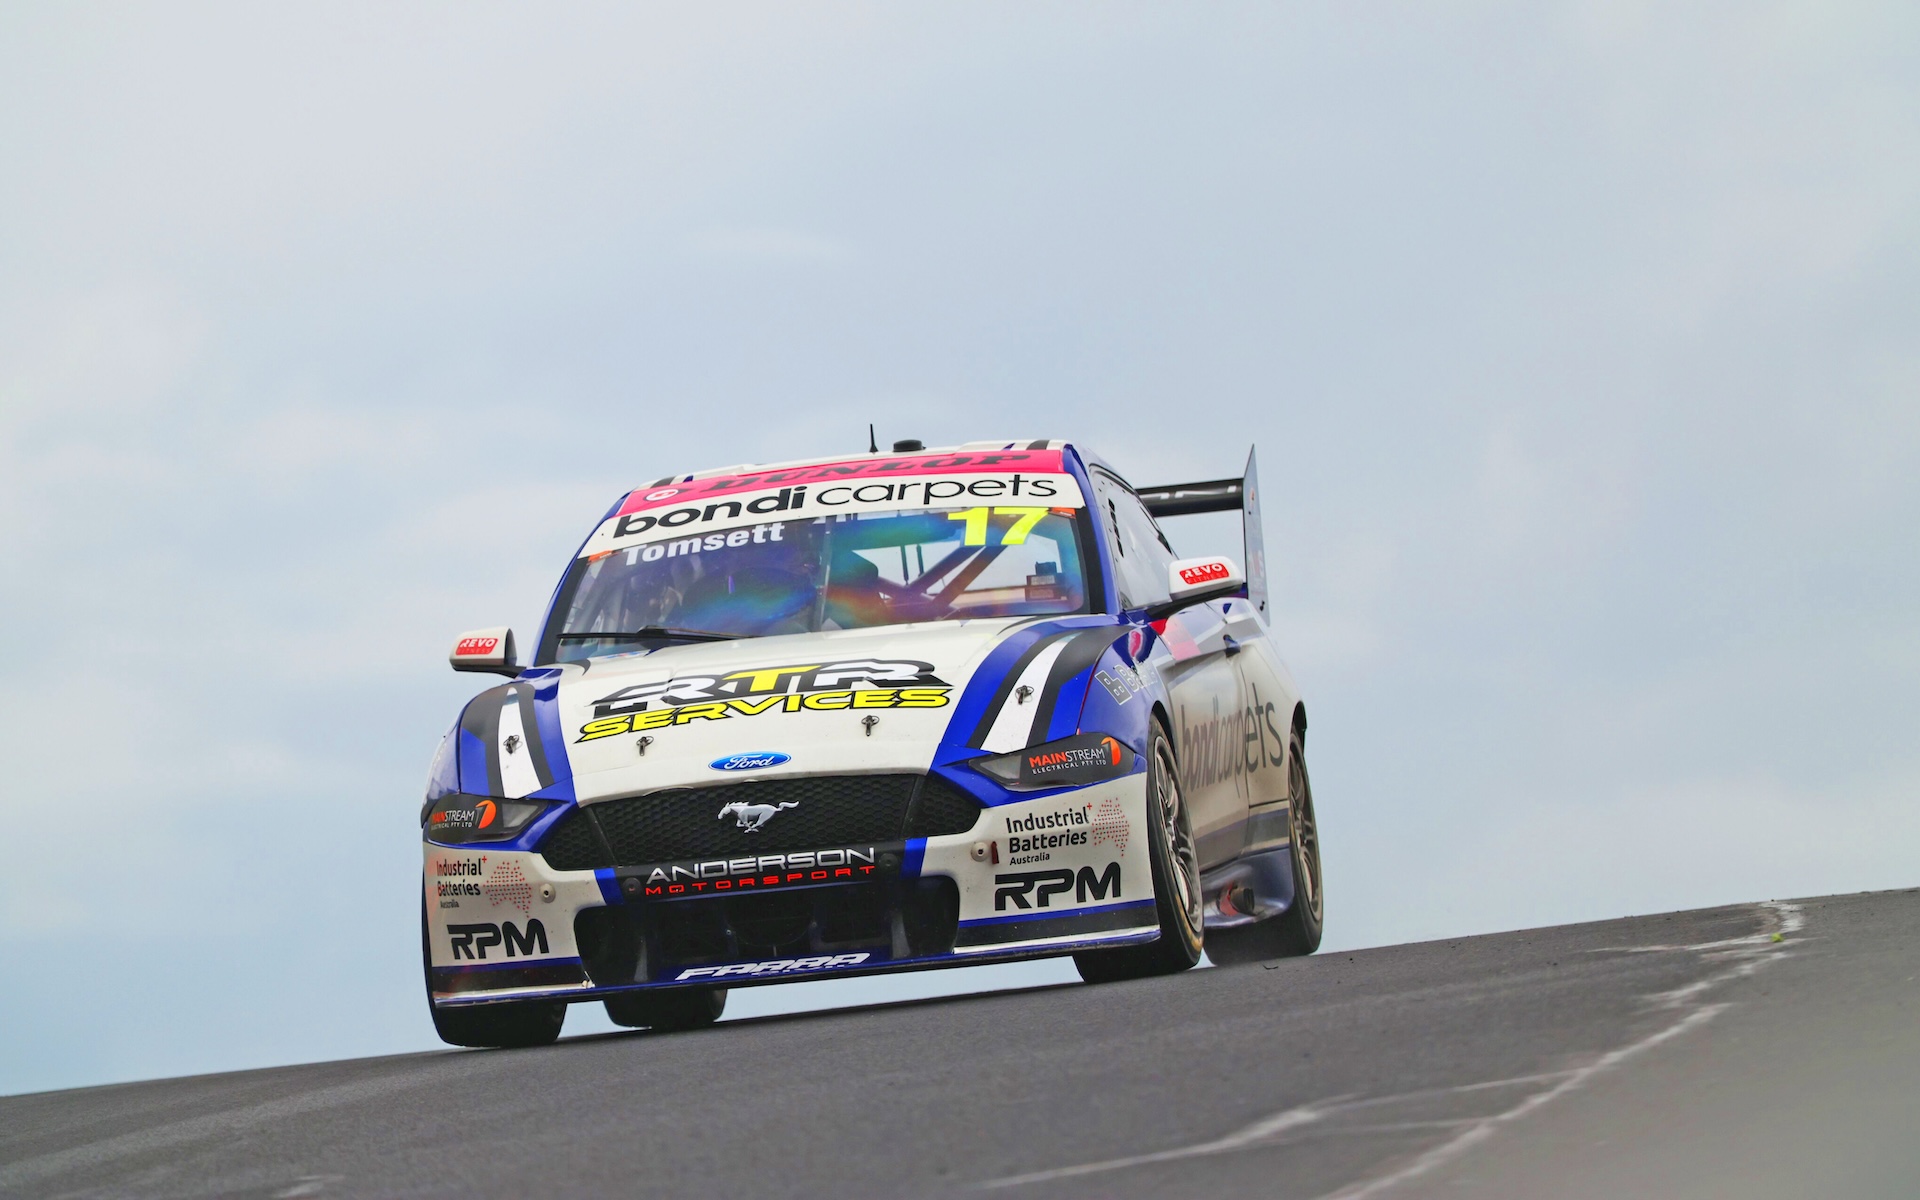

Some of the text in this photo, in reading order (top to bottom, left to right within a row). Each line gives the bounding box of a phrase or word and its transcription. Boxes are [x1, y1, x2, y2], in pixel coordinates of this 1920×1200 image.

[702, 455, 1030, 491] DUNLOP
[613, 474, 1057, 538] bondi carpets
[948, 507, 1048, 546] 17
[623, 522, 785, 566] Tomsett
[1185, 564, 1223, 578] REVO
[460, 639, 496, 648] REVO
[592, 659, 952, 719] RTR
[575, 687, 951, 743] SERVICES
[724, 754, 774, 770] Ford
[1028, 748, 1105, 768] MAINSTREAM
[1032, 763, 1079, 774] ELECTRICAL
[1009, 828, 1088, 853] Batteries
[646, 847, 875, 885] ANDERSON
[1009, 852, 1051, 866] Australia
[437, 879, 481, 897] Batteries
[645, 865, 876, 896] MOTORSPORT
[994, 861, 1122, 911] RPM
[446, 918, 550, 960] RPM
